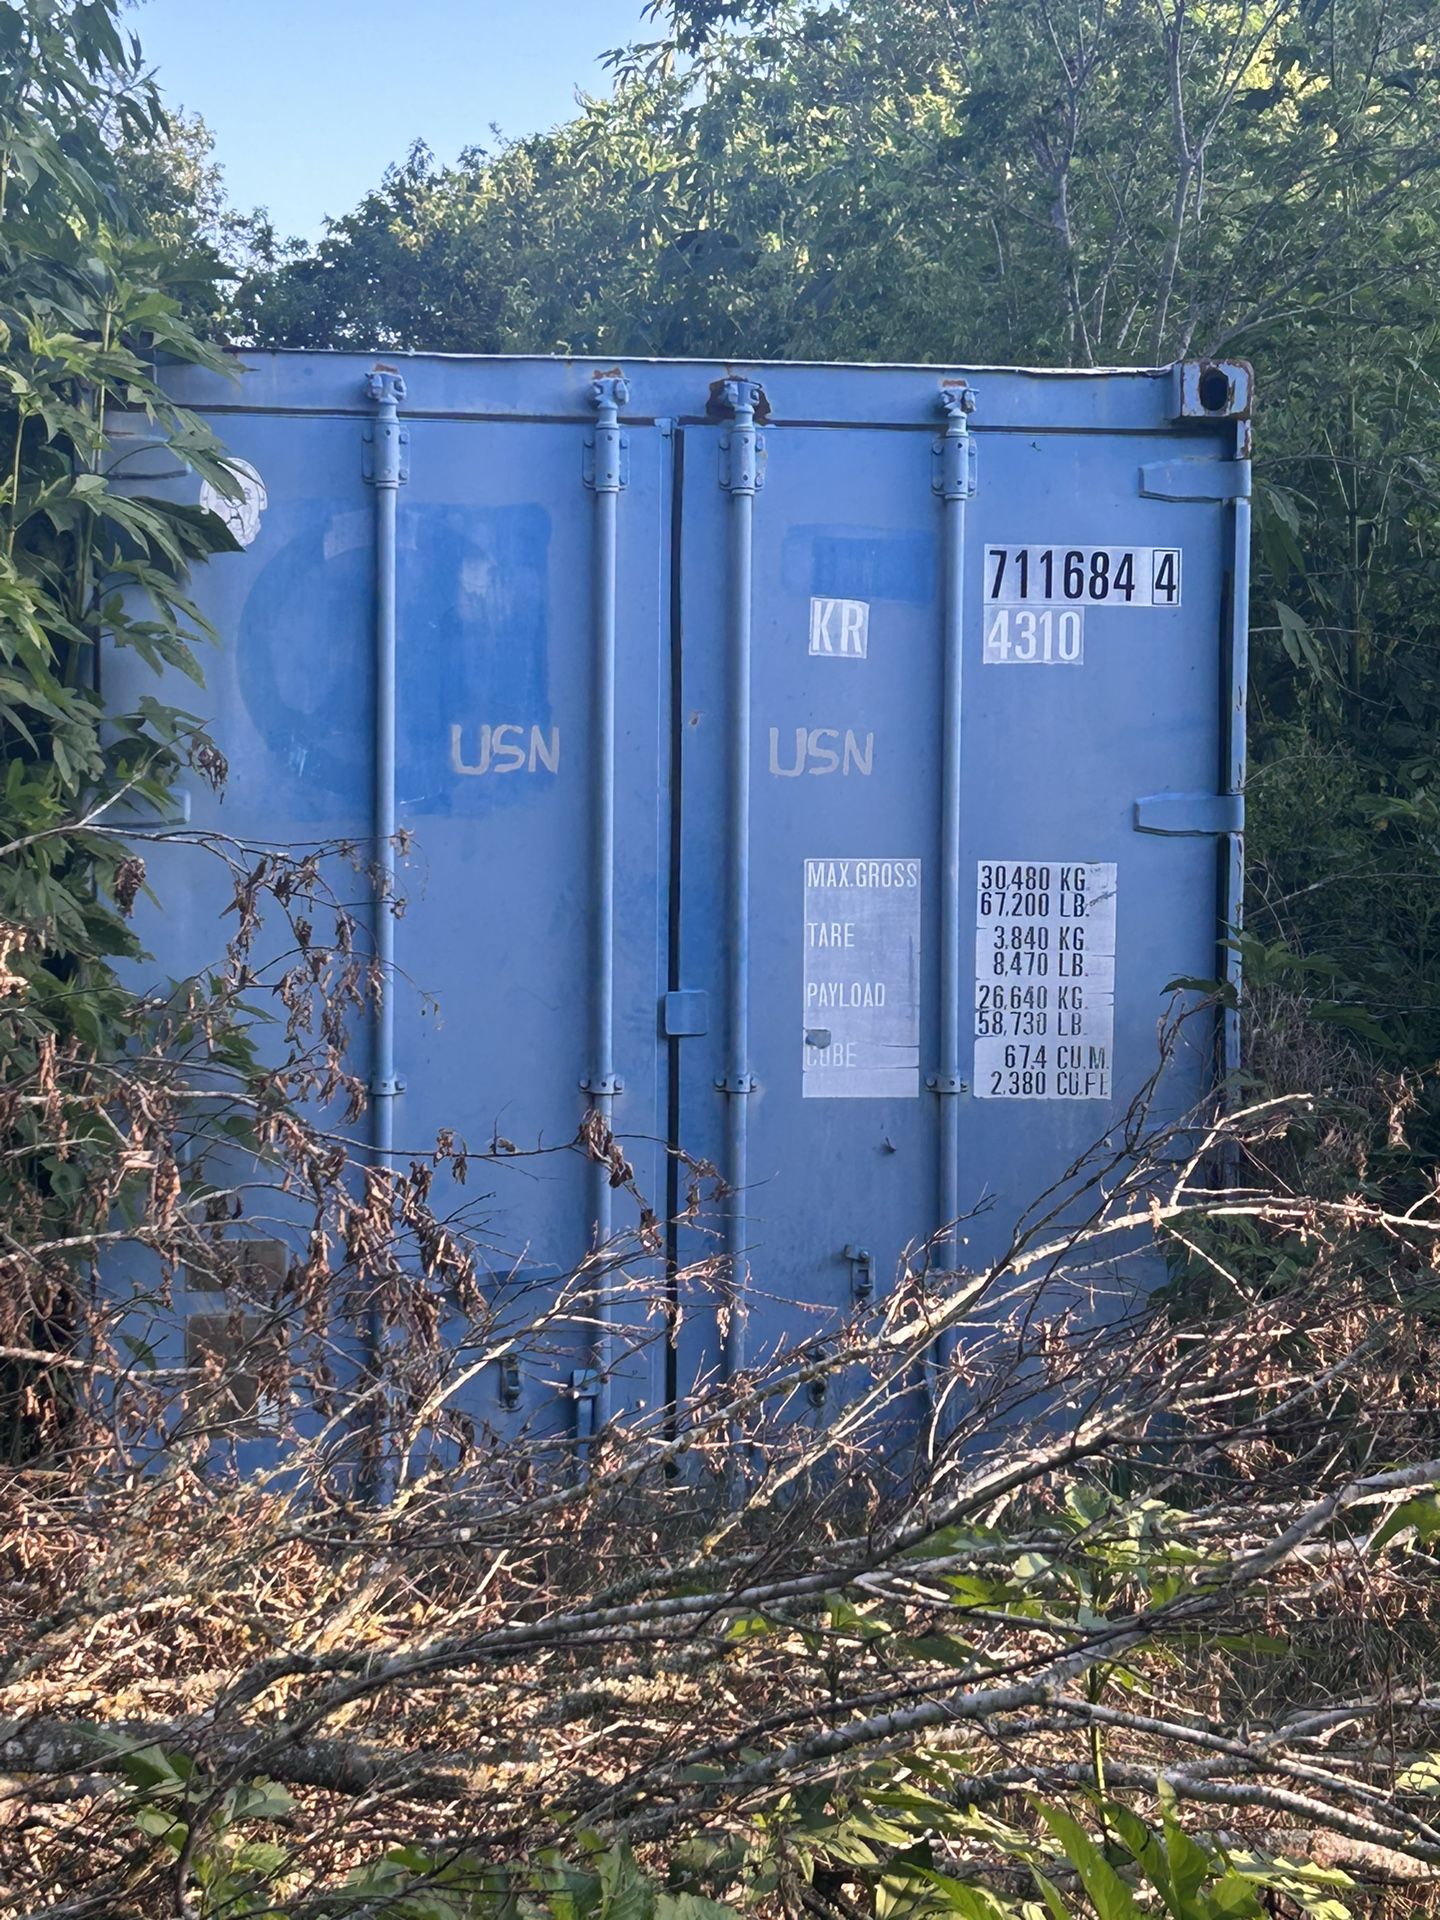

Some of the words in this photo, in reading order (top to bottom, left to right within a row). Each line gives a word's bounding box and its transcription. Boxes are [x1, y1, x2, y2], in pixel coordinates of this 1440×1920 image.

[989, 549, 1136, 602] 711684
[1155, 553, 1177, 602] 4
[812, 600, 864, 654] KR
[987, 609, 1081, 661] 4310
[451, 723, 560, 776] USN
[769, 726, 874, 777] USN
[807, 862, 917, 888] MAX.GROSS
[981, 865, 1050, 891] 30,480
[980, 892, 1049, 917] 67,200
[1060, 893, 1090, 918] LB.
[807, 922, 856, 948] TARE
[993, 925, 1049, 950] 3,840
[993, 951, 1048, 977] 8,470
[1058, 952, 1089, 977] LB.
[807, 982, 886, 1008] PAYLOAD
[978, 984, 1048, 1010] 26,640
[978, 1010, 1047, 1036] 58,730
[1004, 1044, 1047, 1070] 67.4
[990, 1071, 1046, 1096] 2,380
